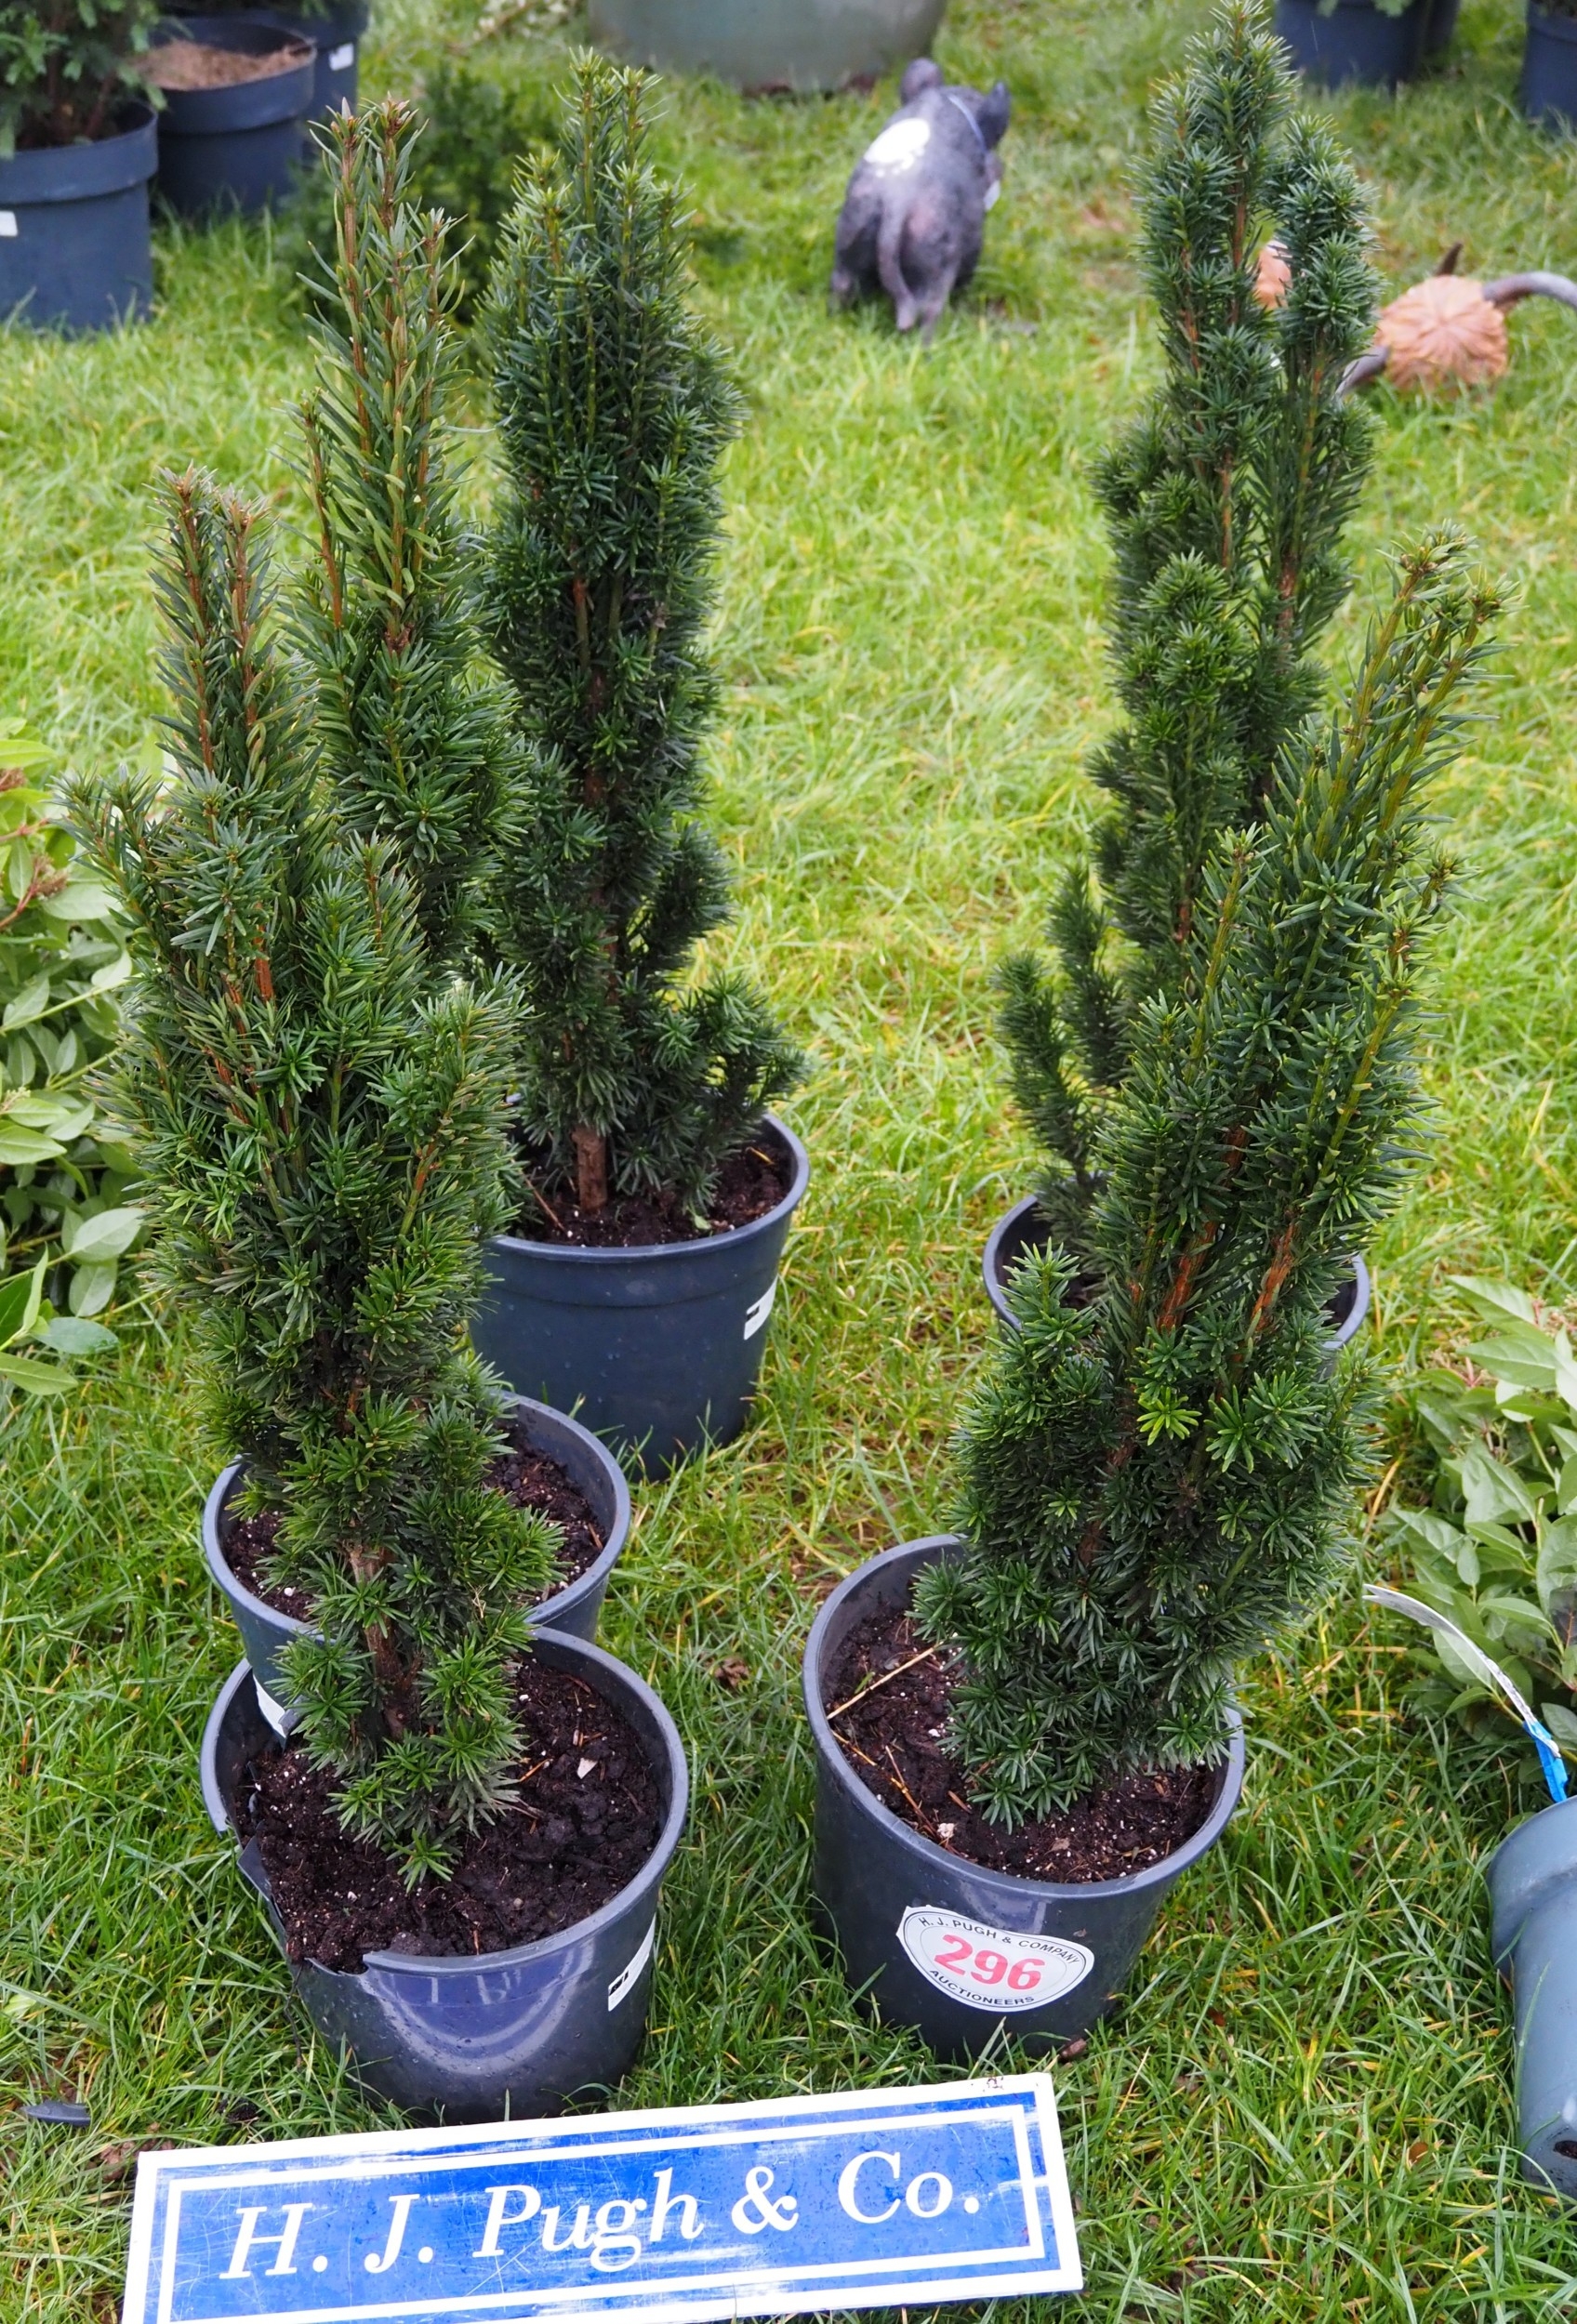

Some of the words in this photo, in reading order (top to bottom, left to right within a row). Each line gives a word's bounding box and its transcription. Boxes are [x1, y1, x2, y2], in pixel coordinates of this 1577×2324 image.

[919, 1917, 934, 1926] H.
[936, 1917, 948, 1927] J.
[952, 1920, 997, 1939] PUGH
[1001, 1935, 1012, 1944] &
[1018, 1939, 1080, 1964] COMPANY
[934, 1934, 1046, 1990] 296
[929, 1969, 1035, 2005] AUCTIONEERS
[219, 2202, 328, 2279] H.
[364, 2193, 434, 2274] J.
[472, 2167, 704, 2272] Pugh
[731, 2166, 800, 2235] &
[838, 2151, 980, 2225] Co.
